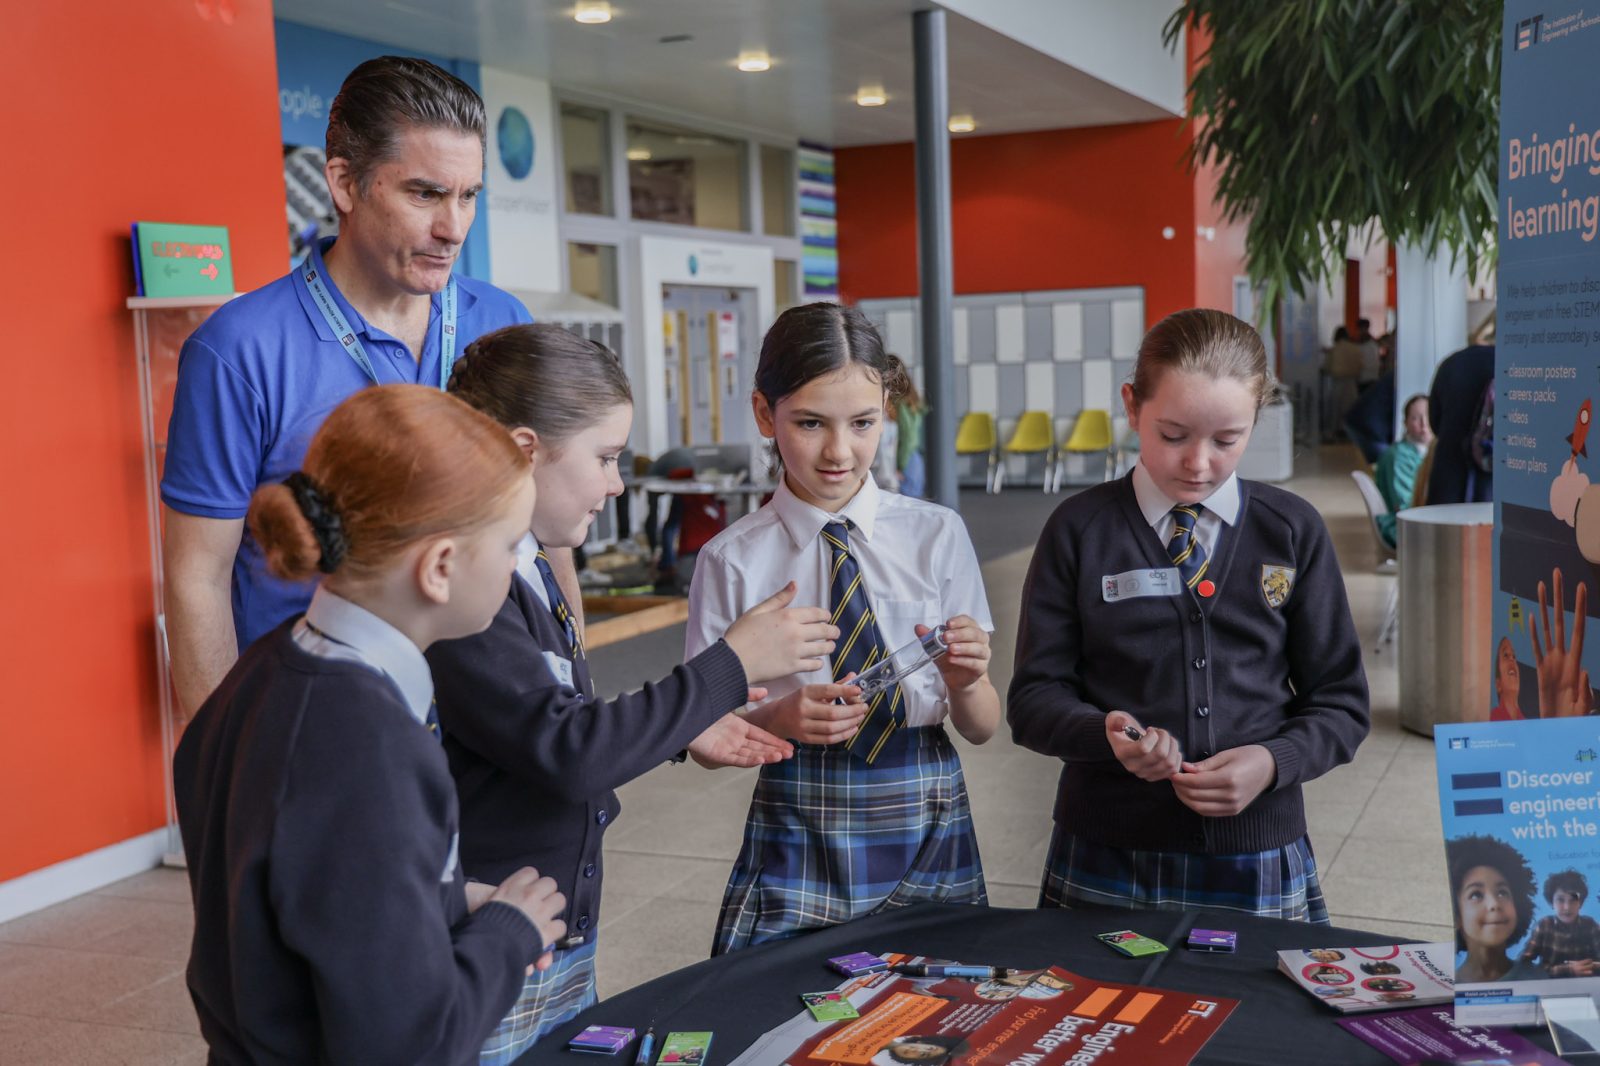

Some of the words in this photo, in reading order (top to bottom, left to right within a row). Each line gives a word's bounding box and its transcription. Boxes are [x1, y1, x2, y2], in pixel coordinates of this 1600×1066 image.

[1508, 122, 1600, 183] Bringing
[1508, 188, 1599, 242] learning
[1547, 326, 1589, 348] secondary
[1508, 363, 1543, 378] classroom
[1545, 366, 1577, 381] posters
[1508, 389, 1532, 401] careers
[1533, 384, 1557, 406] packs
[1508, 408, 1529, 424] videos
[1507, 453, 1527, 470] lesson
[1528, 456, 1548, 474] plans
[1448, 737, 1470, 749] IET
[1507, 769, 1594, 789] Discover
[1512, 818, 1557, 840] with
[1563, 817, 1598, 838] the
[1033, 1015, 1096, 1053] better
